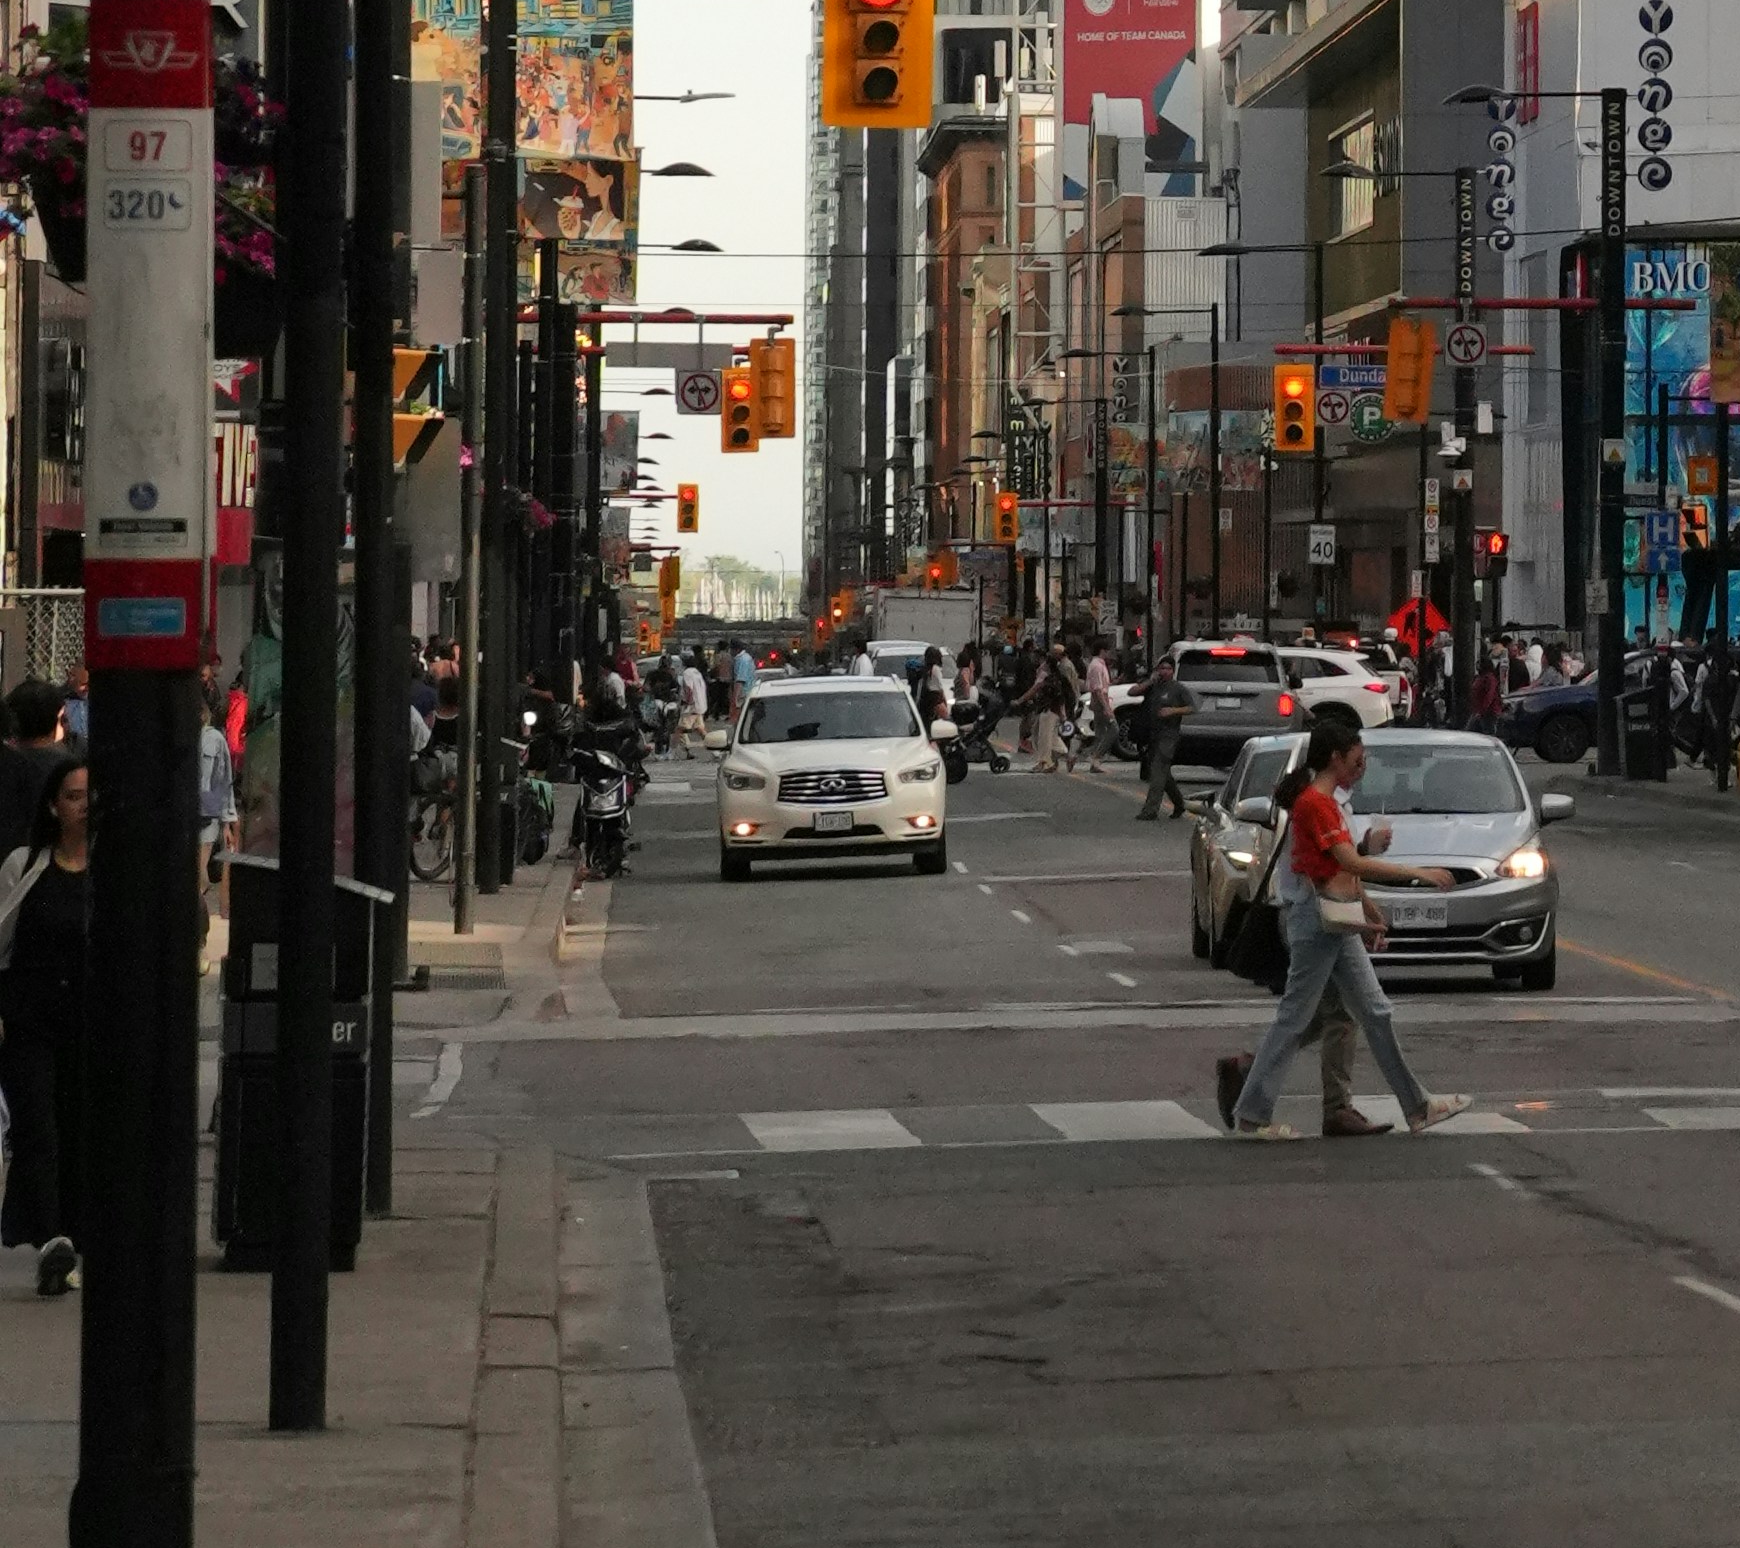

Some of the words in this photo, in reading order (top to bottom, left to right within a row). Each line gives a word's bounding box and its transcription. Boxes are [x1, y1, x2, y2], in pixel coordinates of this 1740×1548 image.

[1077, 31, 1105, 43] HOME
[1105, 31, 1121, 42] OF
[1120, 30, 1148, 42] TEAM
[1147, 29, 1187, 41] CANADA
[1639, 0, 1673, 191] Yonge
[128, 130, 168, 162] 97
[1608, 101, 1622, 238] DOWNTOWN
[108, 188, 165, 220] 320
[1632, 261, 1711, 293] BMO
[1339, 366, 1387, 383] Dunda
[1311, 541, 1334, 559] 40
